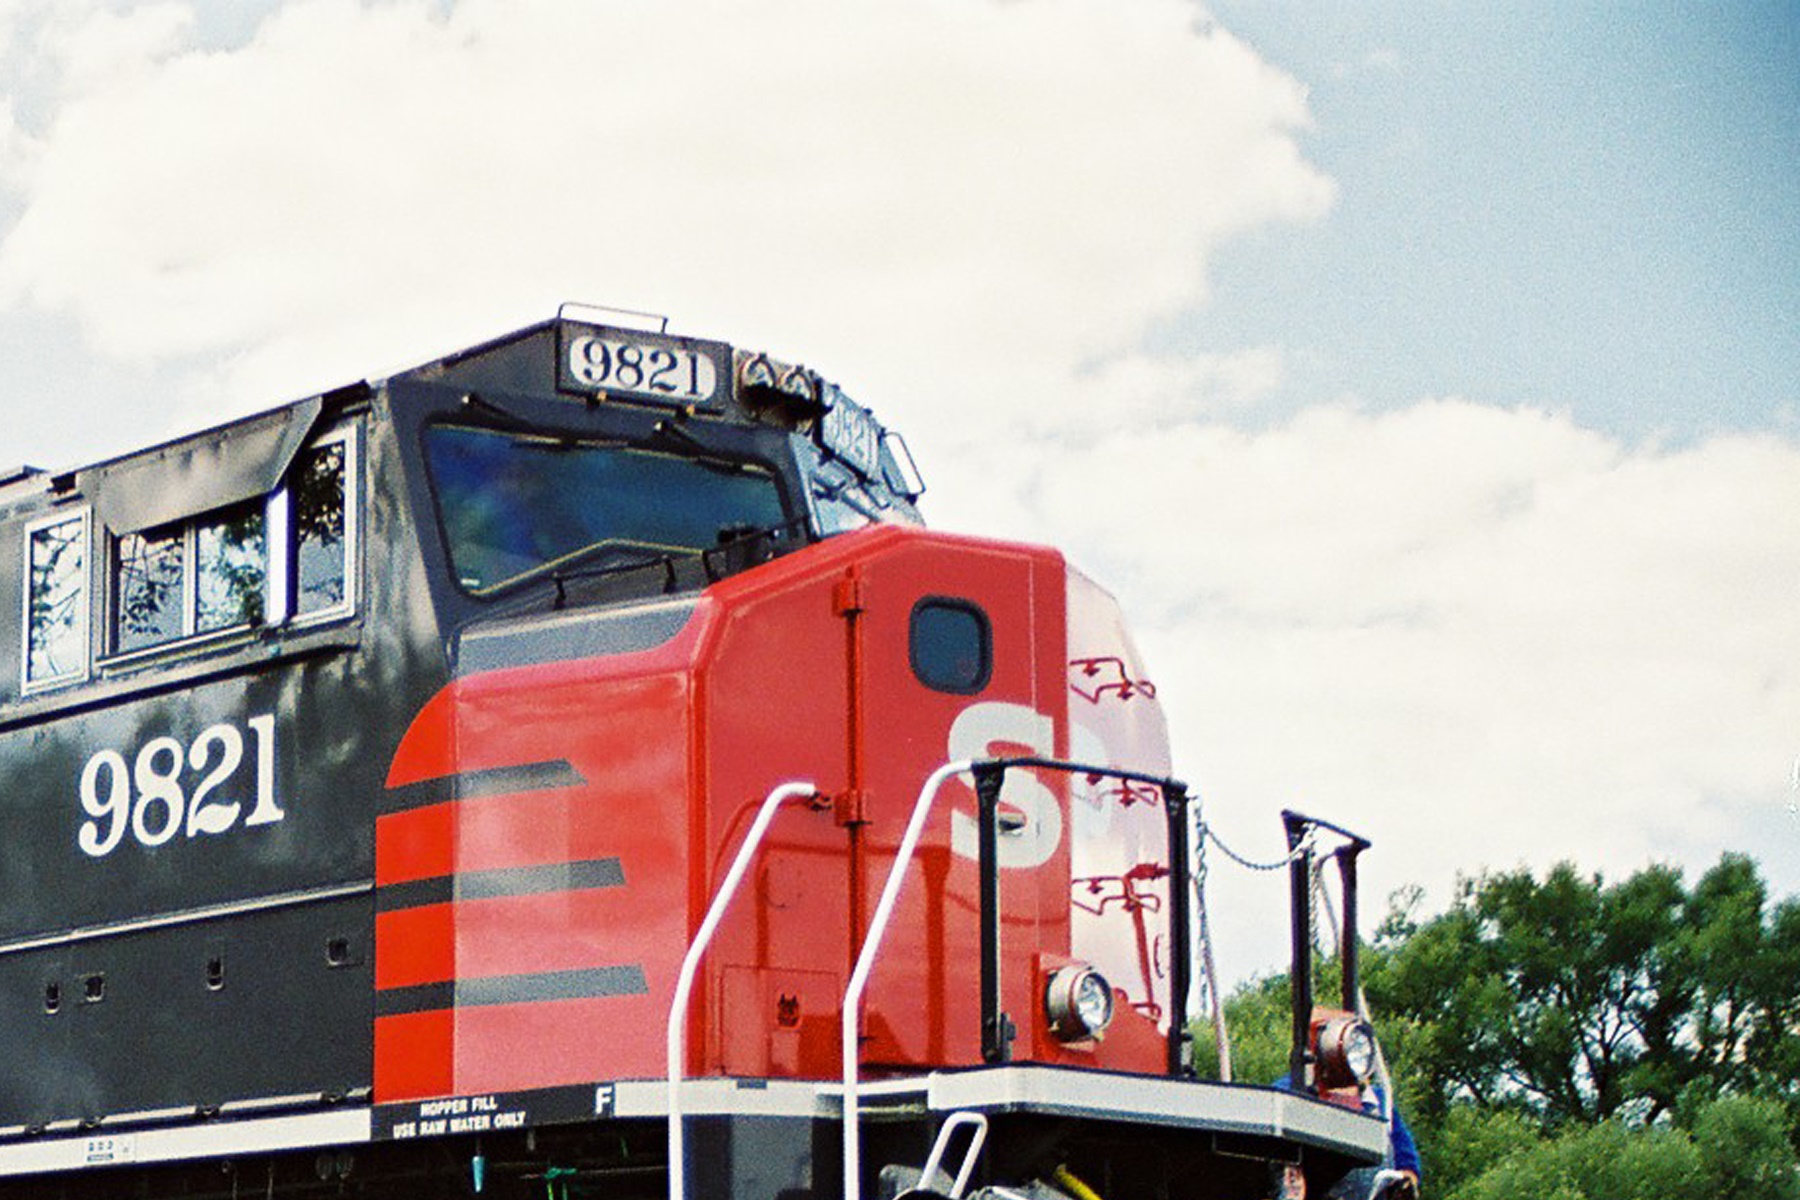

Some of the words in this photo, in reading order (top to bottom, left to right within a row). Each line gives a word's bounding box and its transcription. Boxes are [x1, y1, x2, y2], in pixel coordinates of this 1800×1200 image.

[583, 339, 703, 396] 9821
[78, 713, 285, 857] 9821
[947, 700, 1062, 869] S
[420, 1099, 467, 1117] HOPPER
[471, 1096, 498, 1112] FILL
[595, 1086, 613, 1115] F
[393, 1122, 416, 1139] USE
[450, 1115, 491, 1133] WATER
[494, 1111, 526, 1129] ONLY
